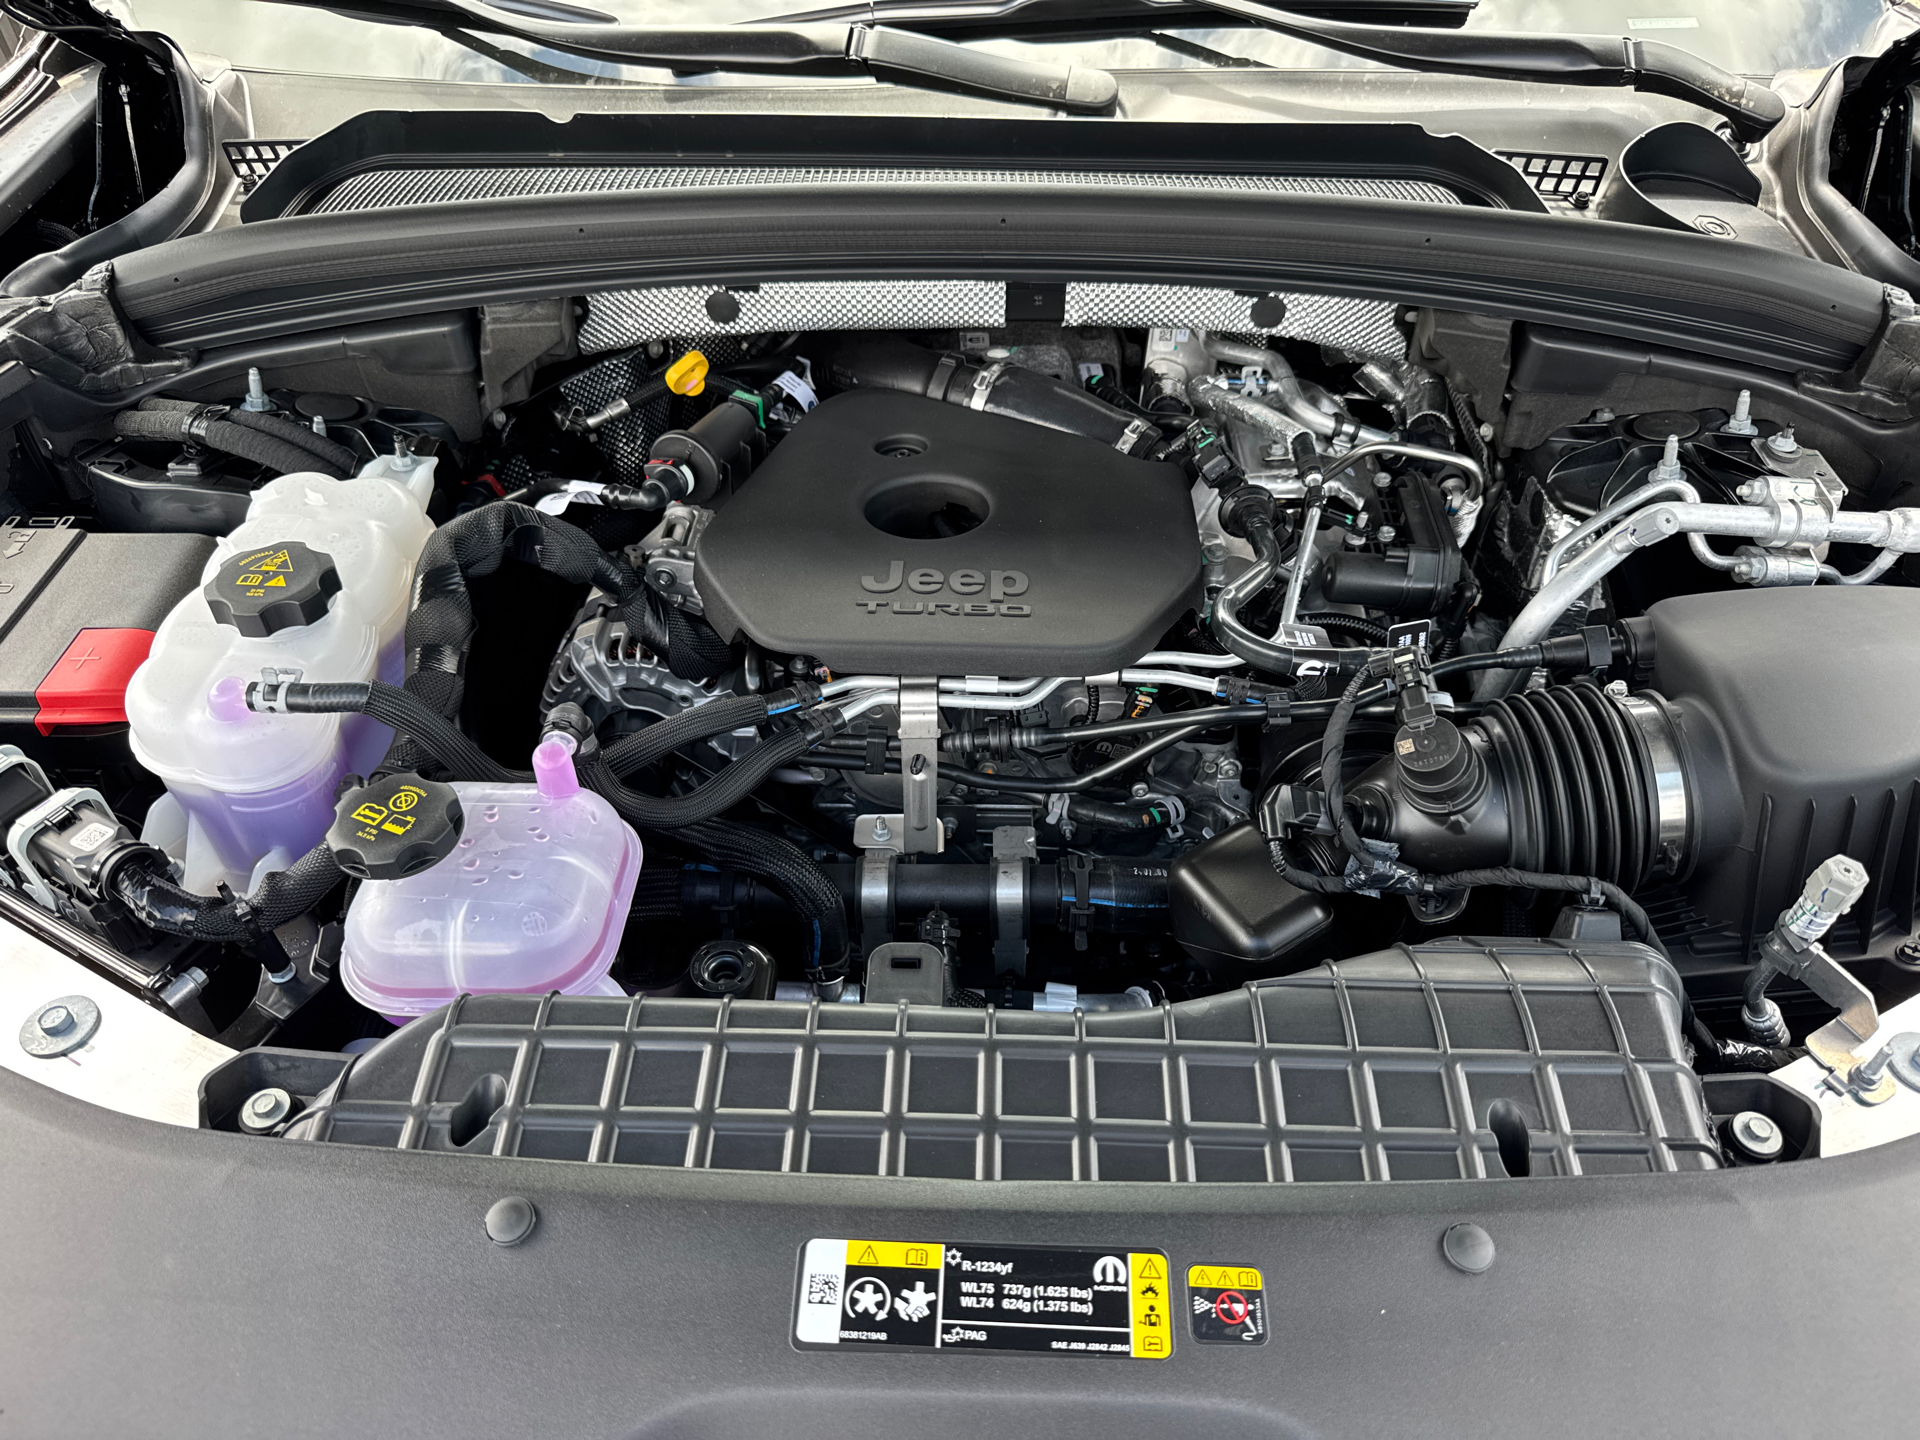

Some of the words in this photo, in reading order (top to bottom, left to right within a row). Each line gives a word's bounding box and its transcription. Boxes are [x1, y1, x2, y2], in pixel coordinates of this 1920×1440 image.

[860, 560, 1029, 603] Jeep
[856, 601, 1032, 617] TURBO
[961, 1260, 1014, 1275] R-1234yf
[960, 1281, 995, 1294] WL75
[1002, 1284, 1031, 1298] 737g
[1033, 1285, 1069, 1298] (1.625
[1070, 1286, 1094, 1300] lbs)
[960, 1296, 995, 1309] WL74
[1001, 1298, 1031, 1313] 624g
[1033, 1300, 1069, 1313] (1.375
[1070, 1301, 1094, 1315] lbs)
[965, 1331, 988, 1341] PAG
[1051, 1341, 1068, 1349] SAE
